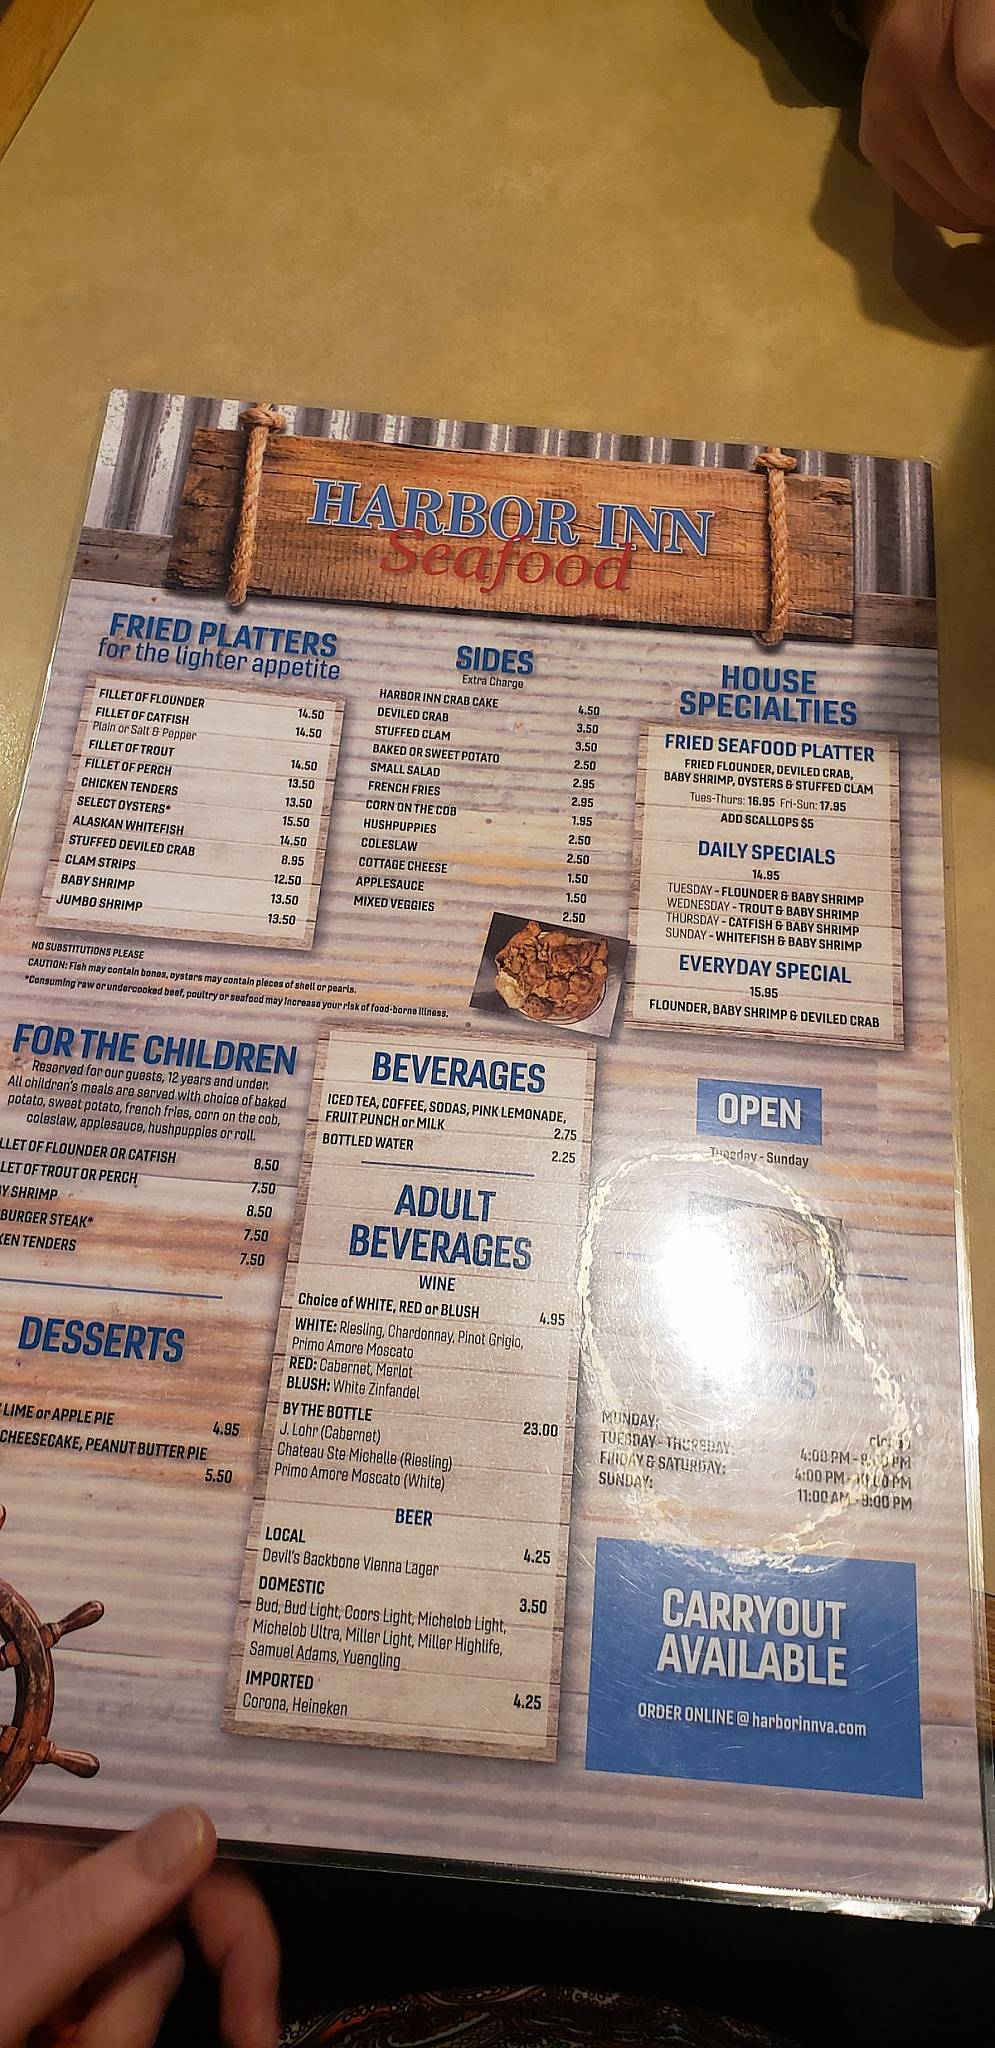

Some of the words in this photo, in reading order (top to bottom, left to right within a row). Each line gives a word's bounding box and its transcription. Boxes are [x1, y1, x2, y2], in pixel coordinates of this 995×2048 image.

[306, 478, 579, 547] HARBOR
[595, 501, 715, 557] INN
[379, 526, 634, 594] Seafood
[110, 613, 192, 642] FRIED
[198, 621, 338, 657] PLATTERS
[98, 637, 130, 659] for
[135, 641, 169, 663] the
[175, 644, 247, 671] lighter
[251, 657, 339, 680] appetite
[455, 645, 533, 675] SIDES
[462, 673, 487, 685] Extra
[489, 676, 523, 689] Charge
[720, 664, 817, 695] HOUSE
[98, 688, 134, 700] FILLET
[134, 691, 149, 701] OF
[149, 693, 204, 708] FLOUNDER
[379, 688, 420, 701] HARBOR
[422, 692, 441, 703] INN
[443, 694, 470, 707] CRAB
[472, 696, 498, 708] CAKE
[679, 687, 857, 726] SPECIALTIES
[95, 706, 130, 719] FILLET
[130, 710, 145, 720] OF
[146, 711, 189, 725] CATFISH
[298, 708, 324, 719] 14.50
[577, 705, 599, 718] 4.50
[92, 720, 115, 732] Plain
[117, 724, 129, 733] or
[130, 724, 149, 735] Salt
[151, 726, 159, 736] &
[161, 727, 196, 741] Pepper
[295, 726, 322, 738] 14.50
[374, 725, 419, 738] STUFFED
[421, 729, 450, 740] CLAM
[88, 739, 124, 751] FILLET
[124, 742, 139, 753] OF
[140, 744, 175, 756] TROUT
[575, 741, 597, 752] 3.50
[665, 733, 713, 750] FRIED
[717, 737, 796, 756] SEAFOOD
[801, 742, 874, 762] PLATTER
[290, 759, 317, 770] 14.50
[370, 761, 405, 774] SMALL
[406, 764, 440, 776] SALAD
[81, 776, 128, 790] CHICKEN
[130, 781, 178, 795] TENDERS
[572, 778, 594, 788] 2.95
[76, 795, 117, 808] SELECT
[285, 797, 312, 808] 13.50
[689, 791, 745, 805] Tues-Thurs:
[747, 795, 774, 807] 16.95
[780, 797, 817, 810] Fri-Sun:
[819, 800, 846, 811] 17.95
[72, 815, 123, 829] ALASKAN
[125, 819, 184, 835] WHITEFISH
[282, 815, 309, 827] 15.50
[363, 817, 436, 833] HUSHPUPPIES
[720, 812, 742, 823] ADD
[744, 814, 798, 827] SCALLOPS
[800, 817, 813, 828] $5
[68, 834, 116, 848] STUFFED
[118, 839, 164, 853] DEVILED
[166, 843, 195, 856] CRAB
[279, 835, 307, 846] 14.50
[360, 837, 417, 851] COLESLAW
[568, 834, 591, 845] 2.50
[281, 854, 304, 866] 8.95
[566, 853, 589, 864] 2.50
[698, 840, 748, 858] DAILY
[751, 844, 835, 864] SPECIALS
[752, 869, 779, 880] 14.95
[353, 895, 388, 907] MIXED
[390, 897, 434, 911] VEGGIES
[562, 911, 585, 923] 2.50
[31, 940, 44, 950] NO
[45, 942, 111, 956] SUBSTITUTIONS
[112, 948, 144, 959] PLEASE
[27, 957, 68, 969] CAUTION:
[68, 961, 86, 971] Fish
[87, 964, 106, 974] may
[107, 966, 139, 975] contain
[140, 967, 168, 979] bones,
[169, 972, 202, 981] oysters
[203, 975, 222, 984] may
[222, 976, 254, 985] contain
[255, 977, 283, 988] pieces
[284, 980, 294, 988] of
[294, 981, 315, 990] shell
[326, 984, 356, 993] pearls.
[679, 954, 771, 976] EVERYDAY
[775, 961, 851, 983] SPECIAL
[749, 986, 778, 998] 15.95
[12, 1023, 74, 1061] FOR
[80, 1028, 139, 1062] THE
[142, 1034, 297, 1075] CHILDREN
[31, 1059, 84, 1075] Reserved
[85, 1063, 103, 1077] for
[104, 1068, 124, 1078] our
[125, 1070, 164, 1083] guests,
[168, 1071, 179, 1083] 12
[179, 1074, 211, 1086] years
[213, 1076, 233, 1087] and
[235, 1077, 268, 1090] under.
[371, 1051, 545, 1093] BEVERAGES
[327, 1093, 353, 1105] ICED
[355, 1095, 379, 1109] TEA,
[381, 1097, 426, 1113] COFFEE,
[428, 1100, 469, 1116] SODAS,
[471, 1104, 498, 1117] PINK
[500, 1106, 566, 1124] LEMONADE,
[717, 1092, 800, 1129] OPEN
[322, 1132, 372, 1147] BOTTLED
[375, 1136, 413, 1150] WATER
[253, 1158, 279, 1171] 8.50
[551, 1150, 575, 1163] 2.25
[393, 1184, 496, 1222] ADULT
[243, 1228, 268, 1241] 7.50
[348, 1223, 531, 1269] BEVERAGES
[419, 1274, 455, 1291] WINE
[298, 1292, 338, 1307] Choice
[340, 1295, 354, 1308] of
[355, 1296, 396, 1313] WHITE,
[398, 1300, 422, 1313] RED
[424, 1304, 438, 1314] or
[440, 1303, 479, 1318] BLUSH
[539, 1311, 564, 1325] 4.95
[17, 1315, 184, 1362] DESSERTS
[282, 1401, 299, 1415] BY
[300, 1402, 324, 1417] THE
[326, 1405, 372, 1421] BOTTLE
[212, 1420, 240, 1436] 4.95
[522, 1421, 558, 1437] 23.00
[204, 1468, 232, 1483] 5.50
[395, 1507, 432, 1526] BEER
[265, 1526, 305, 1543] LOCAL
[523, 1548, 550, 1564] 4.25
[258, 1575, 325, 1594] DOMESTIC
[519, 1598, 547, 1614] 3.50
[662, 1587, 846, 1639] CARRYOUT
[656, 1632, 847, 1686] AVAILABLE
[245, 1669, 313, 1689] IMPORTED
[242, 1692, 288, 1713] Corona,
[292, 1696, 347, 1716] Heineken
[513, 1693, 541, 1709] 4.25
[637, 1702, 682, 1720] ORDER
[684, 1706, 733, 1725] ONLINE
[736, 1710, 749, 1726] @
[752, 1711, 866, 1736] harborinnva.com
